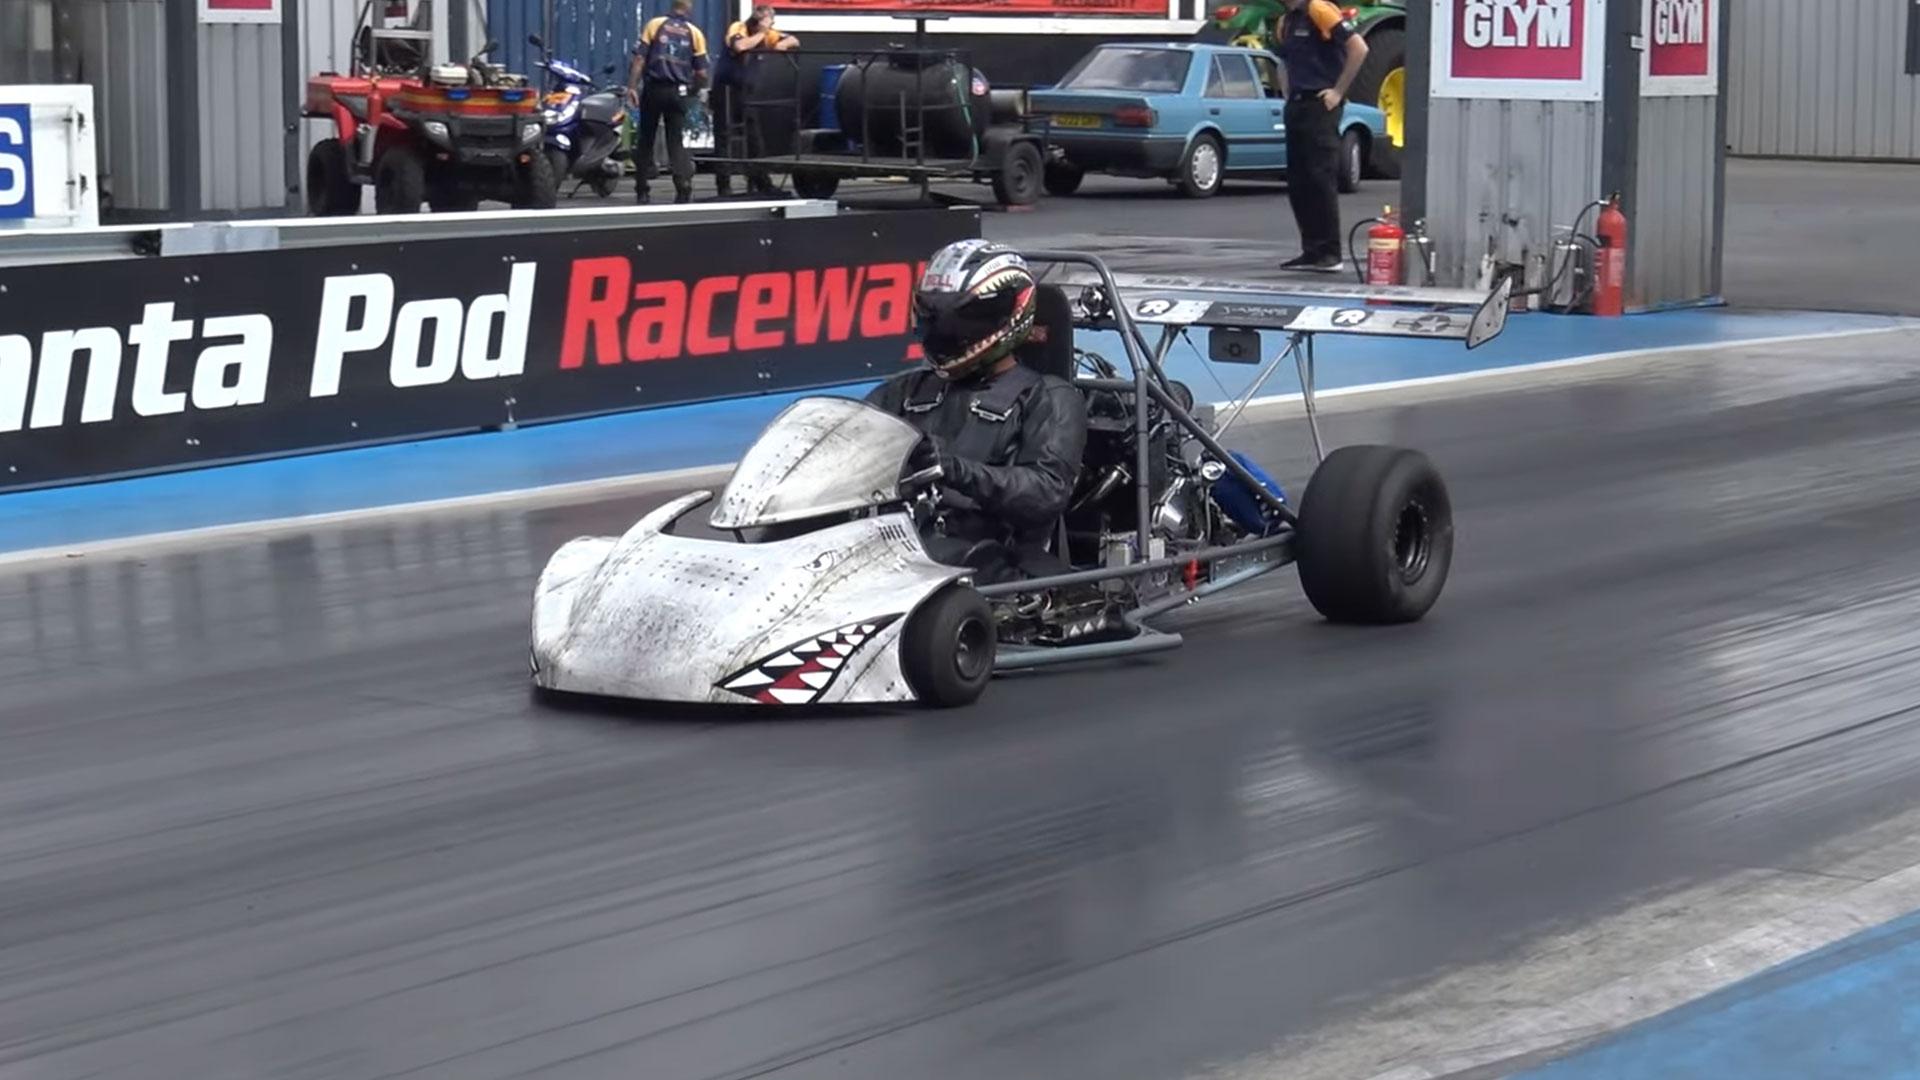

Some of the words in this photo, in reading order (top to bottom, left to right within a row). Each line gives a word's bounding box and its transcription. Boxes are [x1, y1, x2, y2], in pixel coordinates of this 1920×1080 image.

[1463, 2, 1571, 48] GLYM
[1655, 0, 1704, 45] GLYM
[310, 262, 536, 397] Pod
